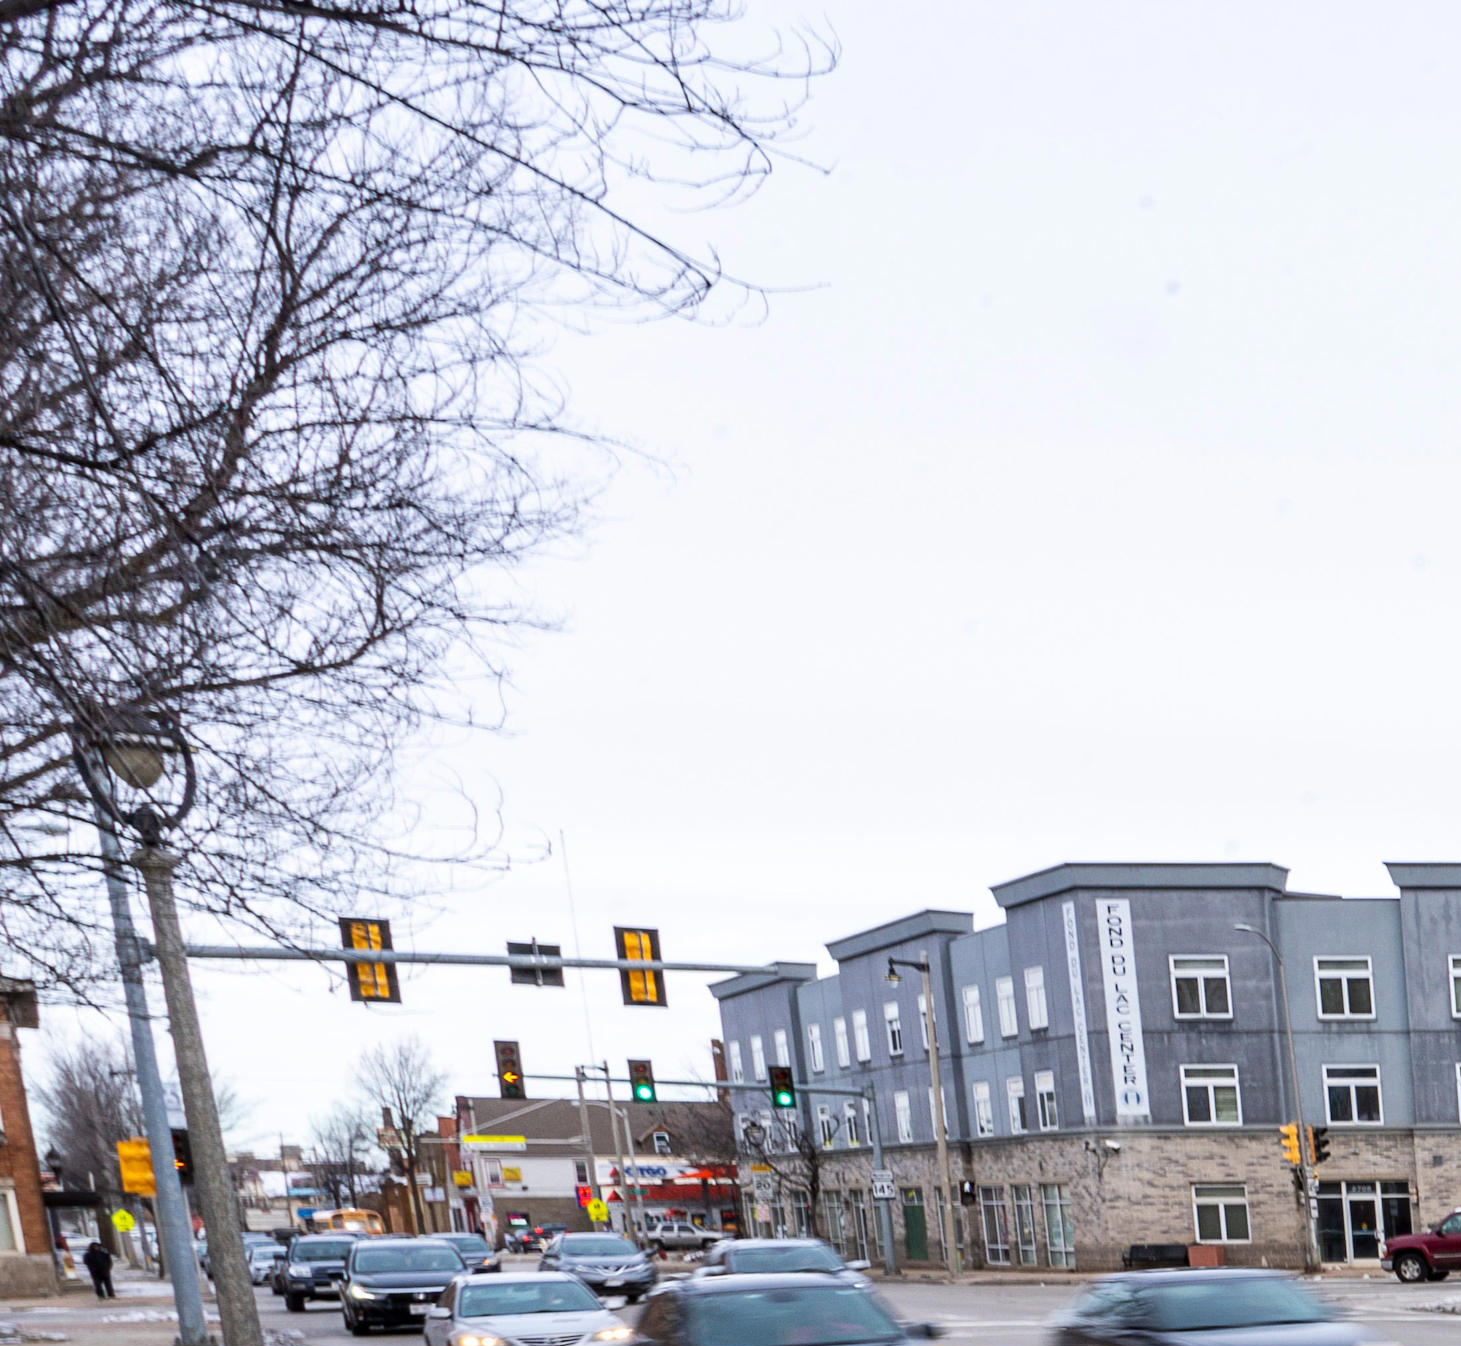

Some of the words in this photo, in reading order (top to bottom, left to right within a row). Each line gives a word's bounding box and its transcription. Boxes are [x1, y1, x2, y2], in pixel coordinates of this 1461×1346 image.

[1106, 903, 1124, 949] FOND
[1111, 954, 1127, 977] DU
[1115, 983, 1131, 1016] LAC
[1118, 1020, 1138, 1086] CENTER
[755, 1182, 771, 1190] 20
[873, 1183, 894, 1195] 145
